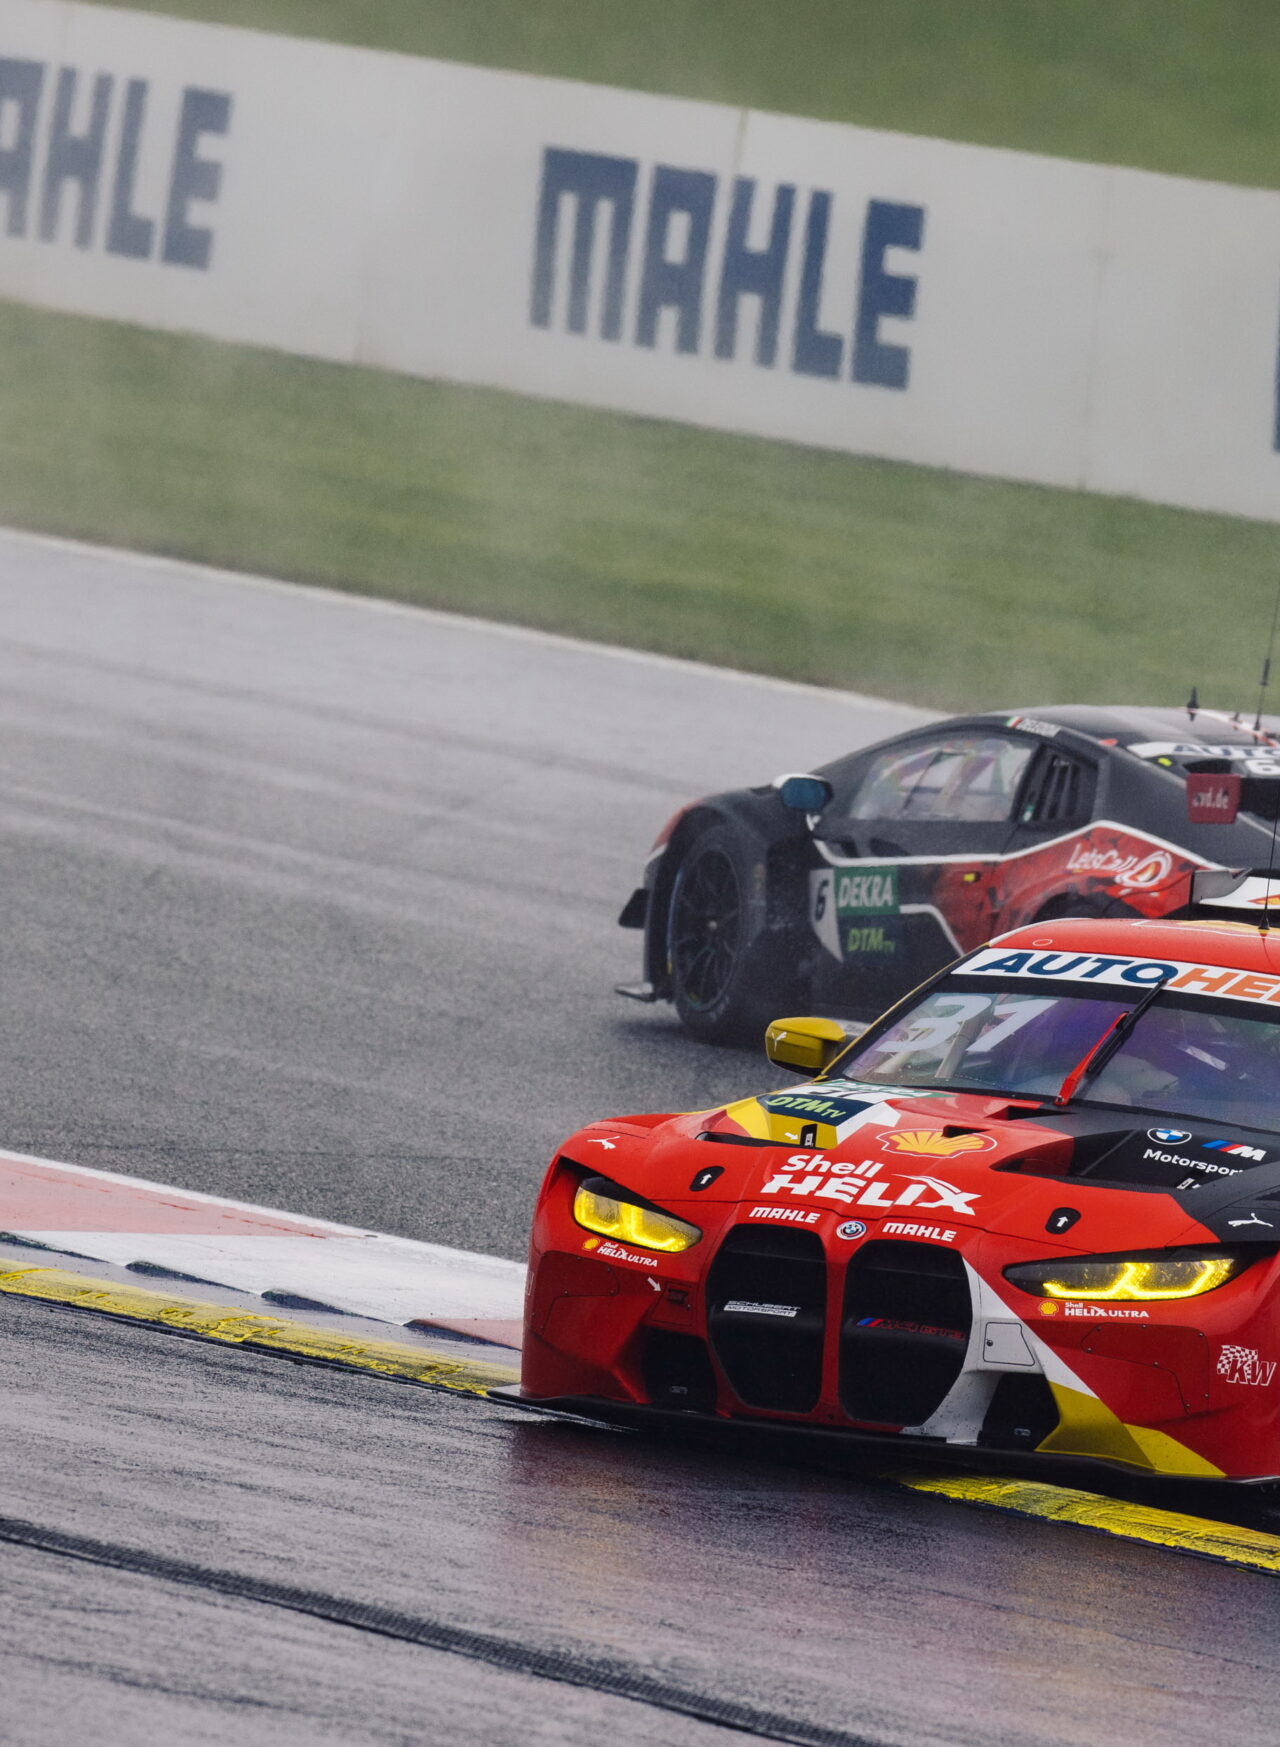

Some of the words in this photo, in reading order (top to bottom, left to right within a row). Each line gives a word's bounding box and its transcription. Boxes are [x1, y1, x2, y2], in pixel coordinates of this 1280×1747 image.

[529, 145, 925, 391] MAHLE
[815, 879, 829, 922] 6
[838, 874, 895, 908] DEKRA
[875, 995, 1060, 1052] 31
[780, 1154, 885, 1178] Shell
[760, 1173, 982, 1216] HELIX
[749, 1206, 821, 1224] MAHLE
[882, 1222, 957, 1242] MAHLE
[1226, 1358, 1277, 1387] KW
